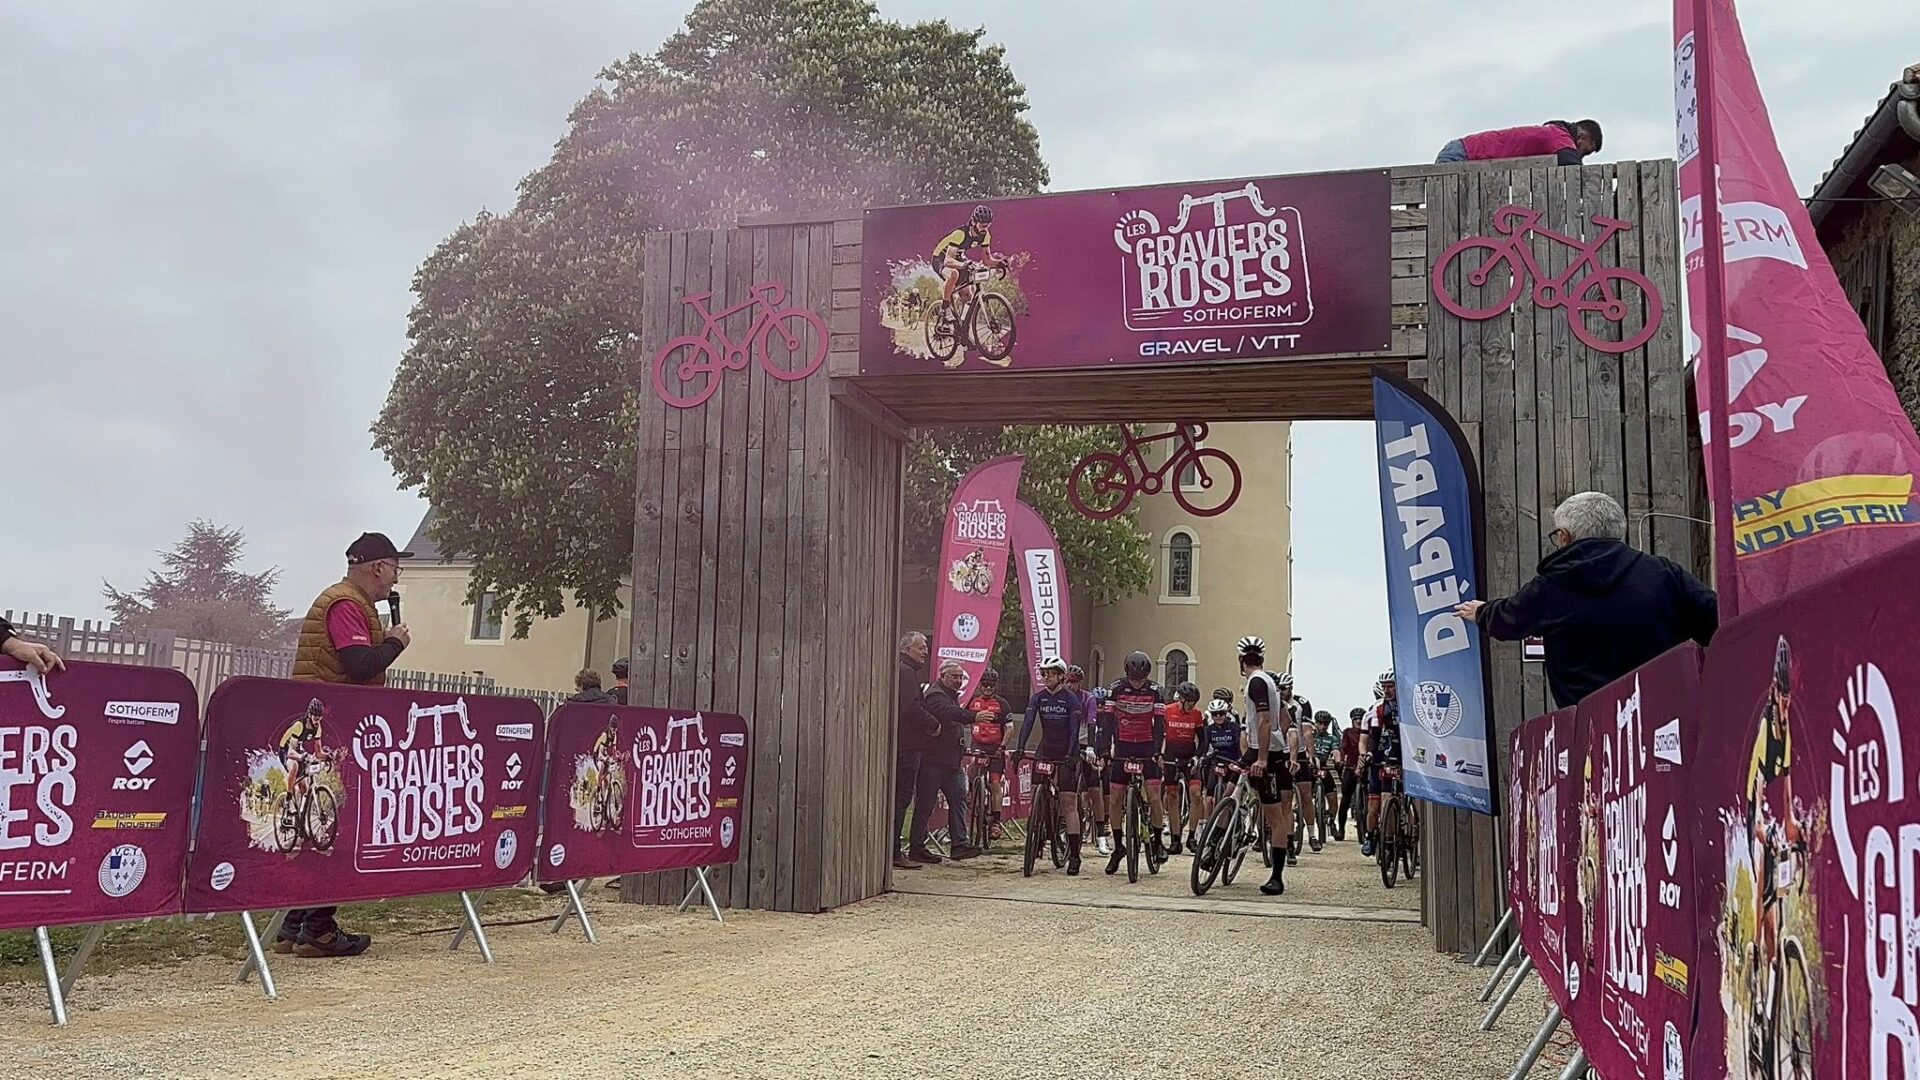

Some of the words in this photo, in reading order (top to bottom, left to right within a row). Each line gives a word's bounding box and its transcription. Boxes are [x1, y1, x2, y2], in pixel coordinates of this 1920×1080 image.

[1126, 223, 1146, 238] LES
[1136, 219, 1289, 267] GRAVIERS
[1140, 248, 1291, 309] ROSES
[1139, 338, 1231, 356] GRAVEL
[1250, 334, 1301, 350] VTT
[958, 511, 1007, 525] GRAVIERS
[958, 522, 1006, 540] ROSES
[364, 733, 382, 748] LES
[639, 740, 650, 752] LES
[372, 743, 484, 791] GRAVIERS
[641, 748, 711, 784] GRAVIERS
[1850, 739, 1880, 805] LES
[112, 777, 156, 790] ROY
[501, 781, 524, 790] ROY
[721, 778, 736, 786] ROY
[373, 777, 484, 845] ROSES
[641, 776, 711, 826] ROSES
[1659, 879, 1681, 909] ROY
